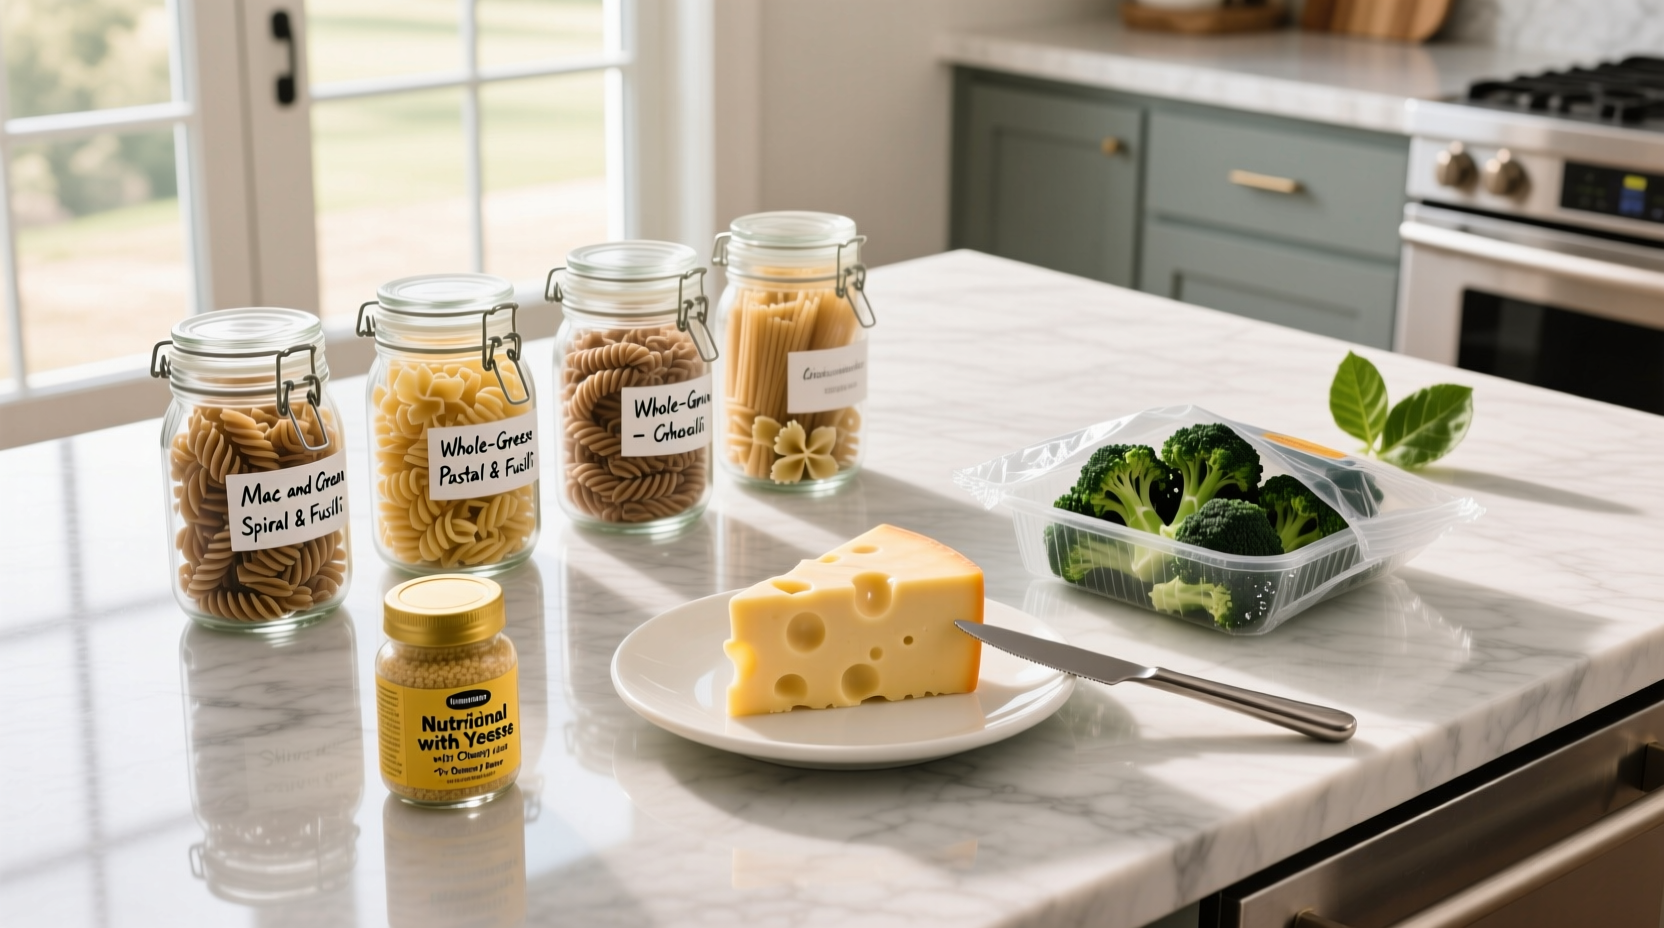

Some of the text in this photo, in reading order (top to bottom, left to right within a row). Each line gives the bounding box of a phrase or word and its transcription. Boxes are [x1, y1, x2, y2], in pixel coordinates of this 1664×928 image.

[489, 460, 500, 479] &
[241, 482, 282, 508] Mac
[287, 475, 312, 498] and
[241, 511, 288, 543] Spiral
[294, 509, 305, 528] &
[417, 733, 460, 751] with
